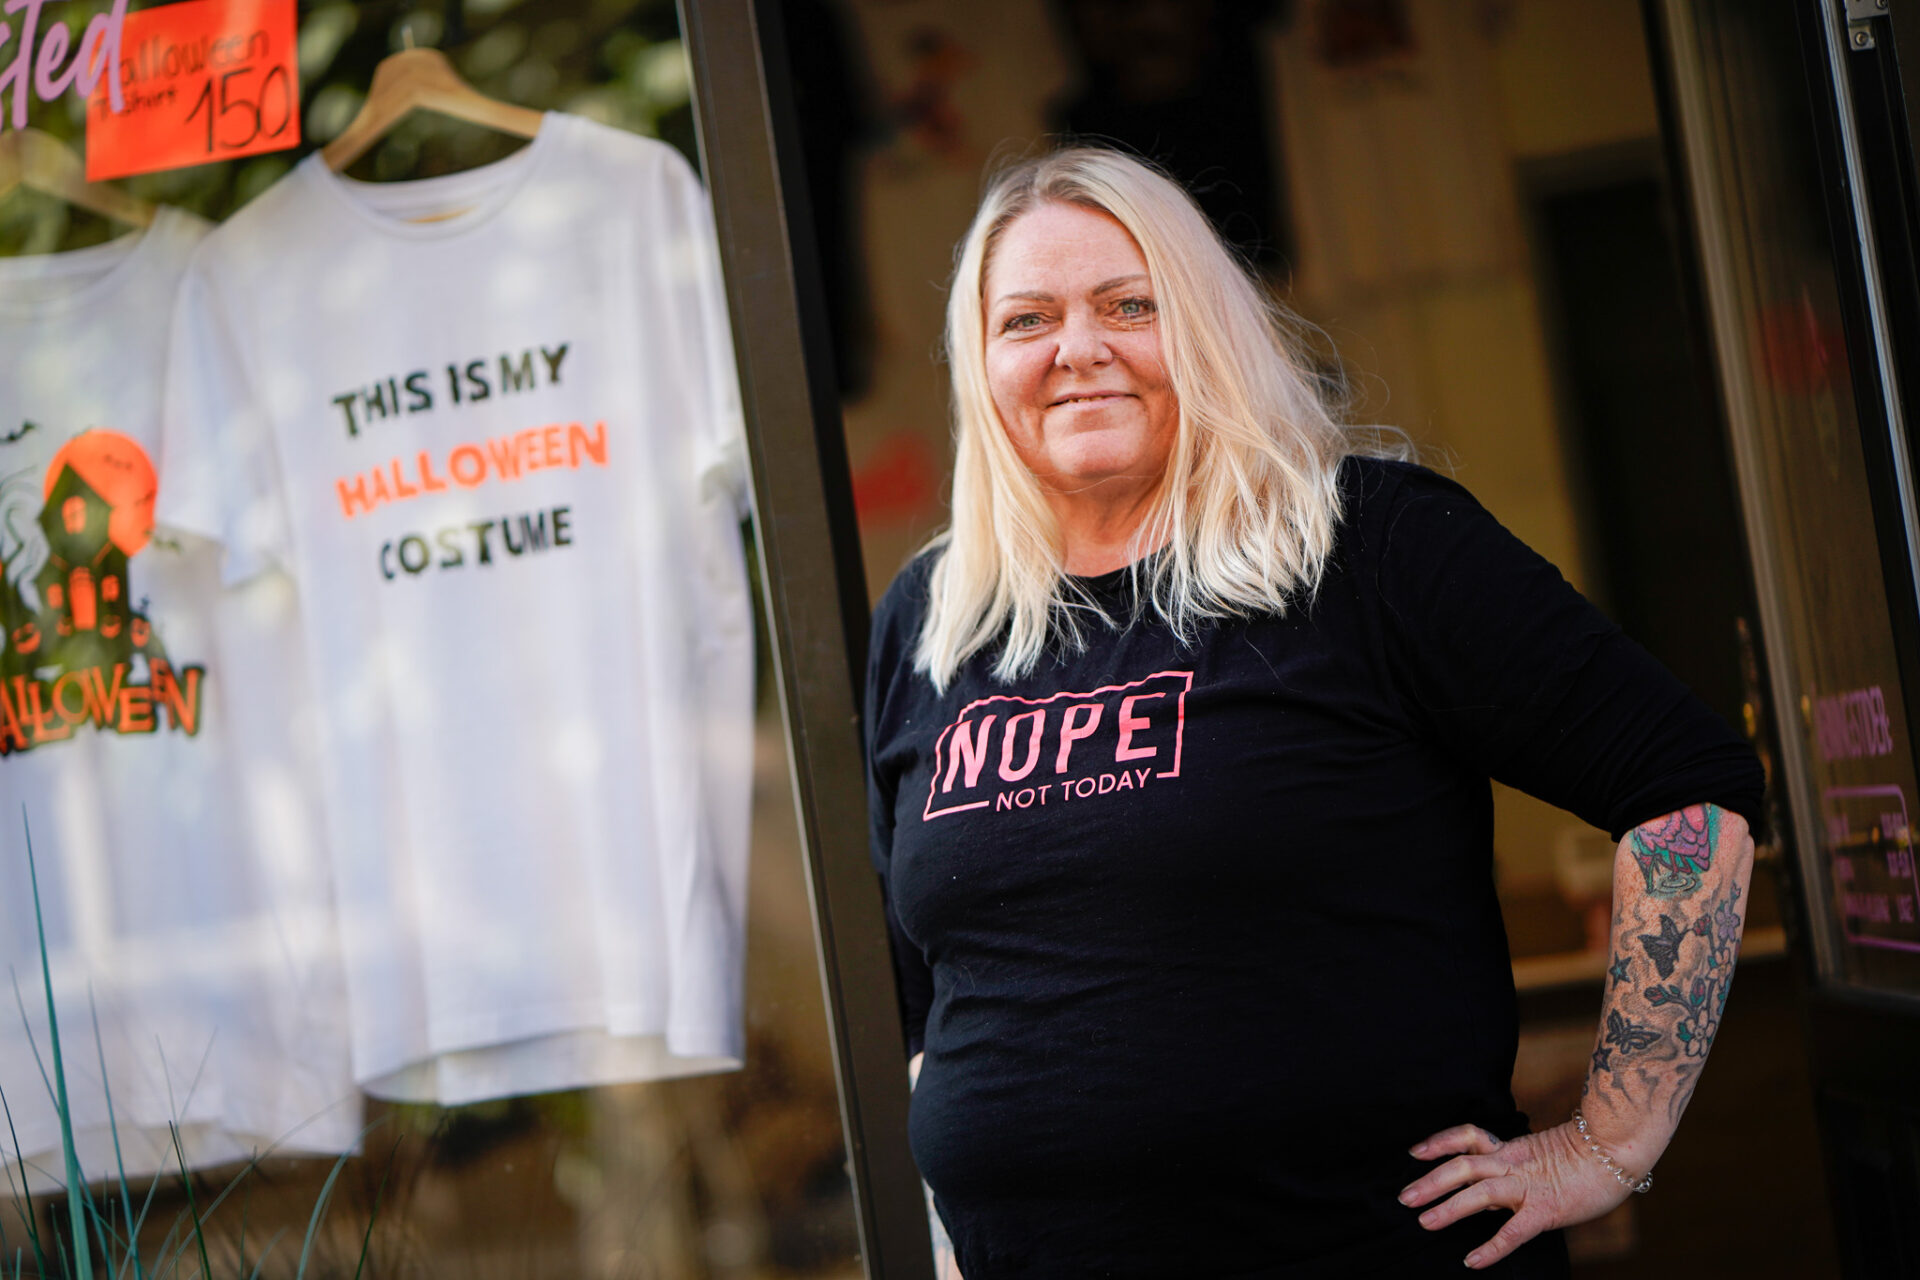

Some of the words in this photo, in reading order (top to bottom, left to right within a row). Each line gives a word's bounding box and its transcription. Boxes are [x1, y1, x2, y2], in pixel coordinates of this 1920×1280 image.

[96, 29, 271, 95] alloween
[184, 64, 292, 153] 150
[332, 369, 433, 438] THIS
[447, 359, 491, 404] IS
[499, 342, 569, 394] MY
[335, 420, 609, 520] HALLOWEEN
[379, 505, 572, 580] COSTUME
[941, 692, 1167, 794] NOPE
[996, 784, 1052, 812] NOT
[1061, 767, 1152, 801] TODAY
